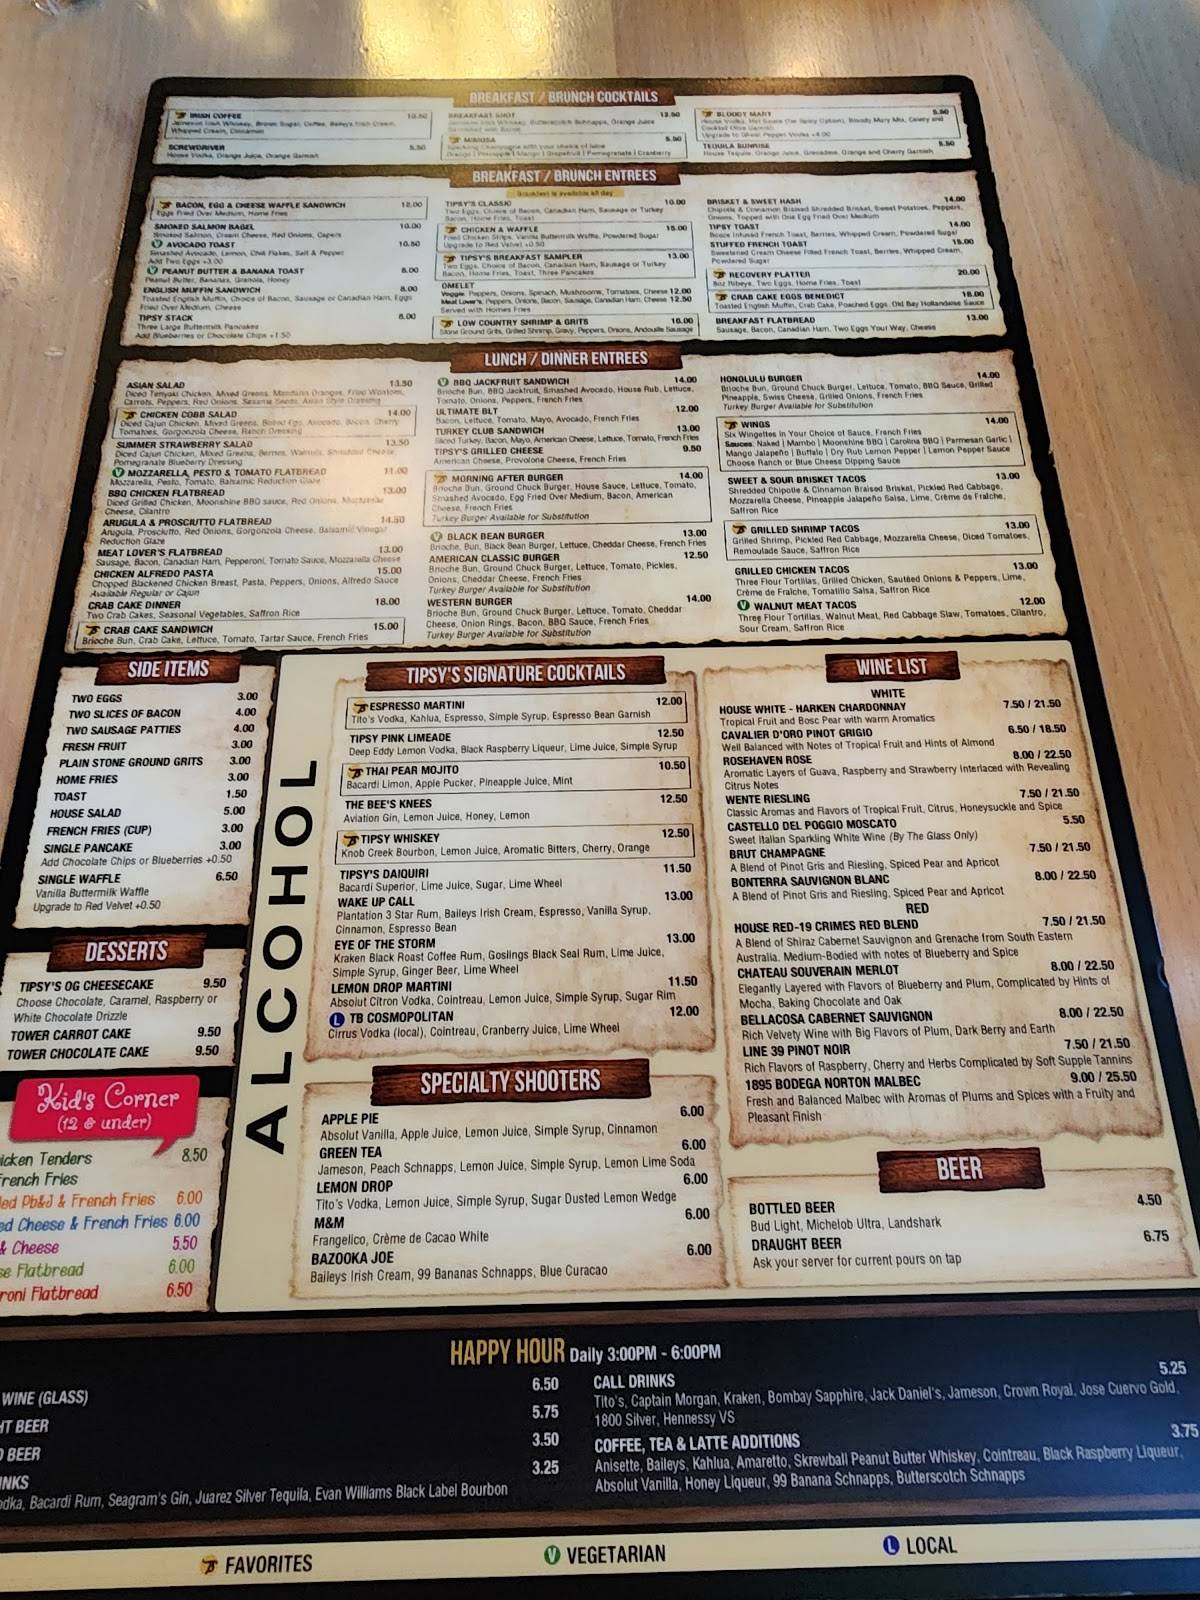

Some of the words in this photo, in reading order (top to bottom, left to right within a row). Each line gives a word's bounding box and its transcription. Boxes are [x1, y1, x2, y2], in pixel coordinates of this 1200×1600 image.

[470, 92, 534, 104] BREAKFAST
[549, 91, 594, 103] BRUNCH
[597, 90, 658, 102] COCKTAILS
[473, 170, 540, 183] BREAKFAST
[554, 170, 601, 182] BRUNCH
[605, 169, 656, 181] ENTREES
[485, 352, 526, 366] LUNCH
[542, 351, 587, 365] DINNER
[591, 350, 648, 364] ENTREES
[126, 382, 153, 390] ASIAN
[760, 537, 792, 546] Shrimp,
[845, 535, 880, 545] Cabbage,
[94, 570, 134, 578] CHICKEN
[106, 611, 127, 619] Crab
[129, 611, 155, 620] Cakes,
[158, 610, 197, 619] Seasonal
[199, 610, 246, 620] Vegetables,
[249, 609, 280, 617] Saffron
[282, 609, 300, 617] Rice
[128, 662, 161, 678] SIDE
[164, 660, 209, 677] ITEMS
[856, 659, 894, 675] WINE
[898, 658, 928, 674] LIST
[407, 667, 460, 684] TIPSY'S
[463, 665, 544, 683] SIGNATURE
[547, 664, 625, 682] COCKTAILS
[870, 688, 905, 698] WHITE
[369, 701, 420, 710] ESPRESSO
[423, 700, 464, 709] MARTINI
[656, 696, 683, 706] 12.00
[721, 730, 769, 740] CAVALIER
[772, 729, 803, 738] D'ORO
[806, 728, 835, 737] PINOT
[838, 728, 872, 737] GRIGIO
[1008, 725, 1029, 733] 6.50
[1039, 724, 1066, 733] 18.50
[59, 758, 89, 767] PLAIN
[91, 758, 125, 767] STONE
[128, 757, 170, 766] GROUND
[173, 756, 203, 766] GRITS
[229, 756, 250, 765] 3.00
[343, 814, 379, 822] Aviation
[382, 813, 399, 823] Gin,
[403, 813, 433, 821] Lemon
[436, 812, 462, 821] Juice,
[466, 811, 495, 822] Honey,
[500, 811, 529, 820] Lemon
[33, 902, 71, 913] Upgrade
[73, 902, 82, 911] to
[85, 901, 103, 910] Red
[106, 901, 132, 910] Velvet
[135, 900, 161, 909] +0.50
[905, 902, 929, 913] RED
[85, 941, 168, 962] DESSERTS
[246, 760, 318, 1155] ALCOHOL
[11, 1030, 49, 1041] TOWER
[53, 1029, 99, 1040] CARROT
[102, 1028, 131, 1039] CAKE
[197, 1026, 221, 1036] 9.50
[421, 1072, 510, 1094] SPECIALTY
[515, 1069, 600, 1092] SHOOTERS
[745, 1079, 772, 1090] 1895
[775, 1077, 821, 1089] BODEGA
[824, 1076, 870, 1088] NORTON
[874, 1075, 920, 1087] MALBEC
[1070, 1071, 1094, 1083] 9.00
[1105, 1070, 1136, 1082] 25.50
[37, 1082, 95, 1113] Kid's
[105, 1082, 180, 1108] Corner
[57, 1115, 78, 1133] (12
[101, 1113, 151, 1131] under)
[682, 1138, 706, 1150] 6.00
[40, 1151, 93, 1166] Tenders
[182, 1148, 208, 1162] 8.50
[319, 1146, 357, 1158] GREEN
[360, 1146, 382, 1157] TEA
[937, 1156, 982, 1180] BEER
[57, 1194, 66, 1208] &
[72, 1193, 116, 1207] French
[122, 1192, 156, 1206] Fries
[177, 1190, 202, 1205] 6.00
[1137, 1193, 1162, 1205] 4.50
[749, 1202, 800, 1214] BOTTLED
[805, 1201, 835, 1213] BEER
[314, 1216, 344, 1228] M&M
[750, 1220, 770, 1232] Bud
[774, 1219, 802, 1233] Light,
[806, 1218, 853, 1230] Michelob
[856, 1218, 884, 1230] Ultra,
[888, 1216, 941, 1228] Landshark
[451, 1338, 510, 1365] HAPPY
[516, 1337, 564, 1363] HOUR
[570, 1347, 603, 1363] Daily
[607, 1345, 656, 1361] 3:00PM
[671, 1344, 720, 1360] 6:00PM
[1159, 1361, 1186, 1374] 5.25
[532, 1376, 558, 1390] 6.50
[593, 1374, 625, 1389] CALL
[628, 1373, 675, 1388] DRINKS
[2, 1391, 35, 1405] WINE
[38, 1389, 88, 1407] (GLASS)
[595, 1413, 622, 1427] 1800
[626, 1412, 659, 1426] Silver,
[663, 1412, 715, 1427] Hennessy
[718, 1410, 735, 1423] VS
[906, 1536, 957, 1554] LOCAL
[566, 1544, 665, 1564] VEGETARIAN
[225, 1554, 312, 1574] FAVORITES
